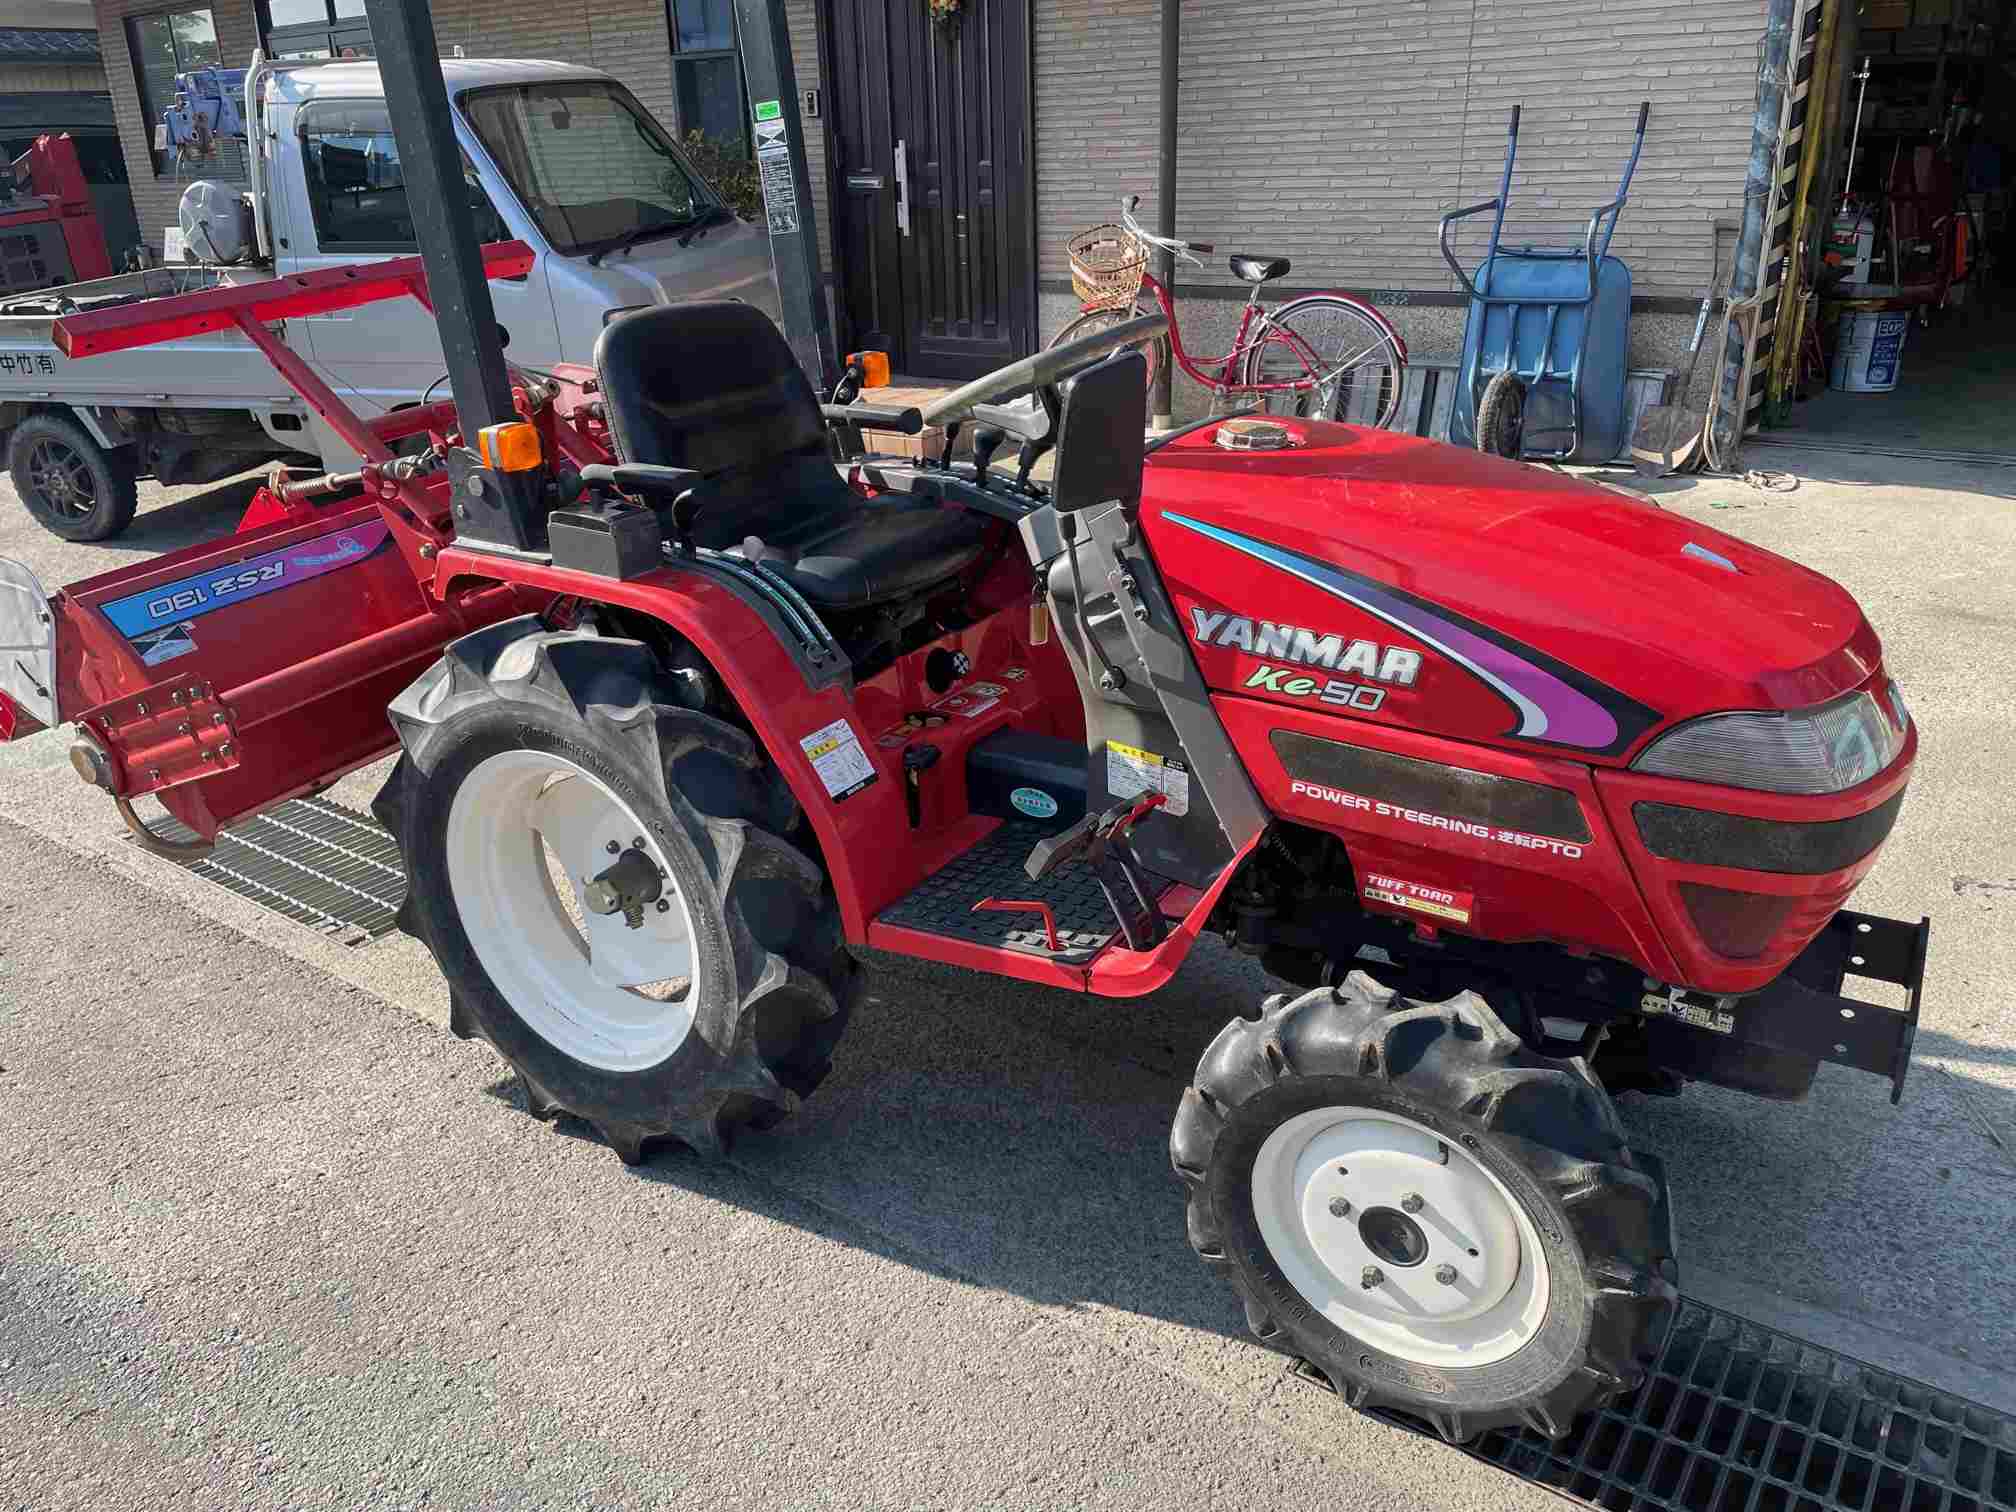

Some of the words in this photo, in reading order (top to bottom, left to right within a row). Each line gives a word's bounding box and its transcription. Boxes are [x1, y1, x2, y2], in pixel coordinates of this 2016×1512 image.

[210, 560, 286, 596] RSZ
[147, 588, 208, 619] 130
[1191, 608, 1424, 688] YANMAR
[1244, 664, 1387, 711] Ke-50
[1291, 782, 1371, 811] POWER
[1367, 874, 1406, 891] TUFF
